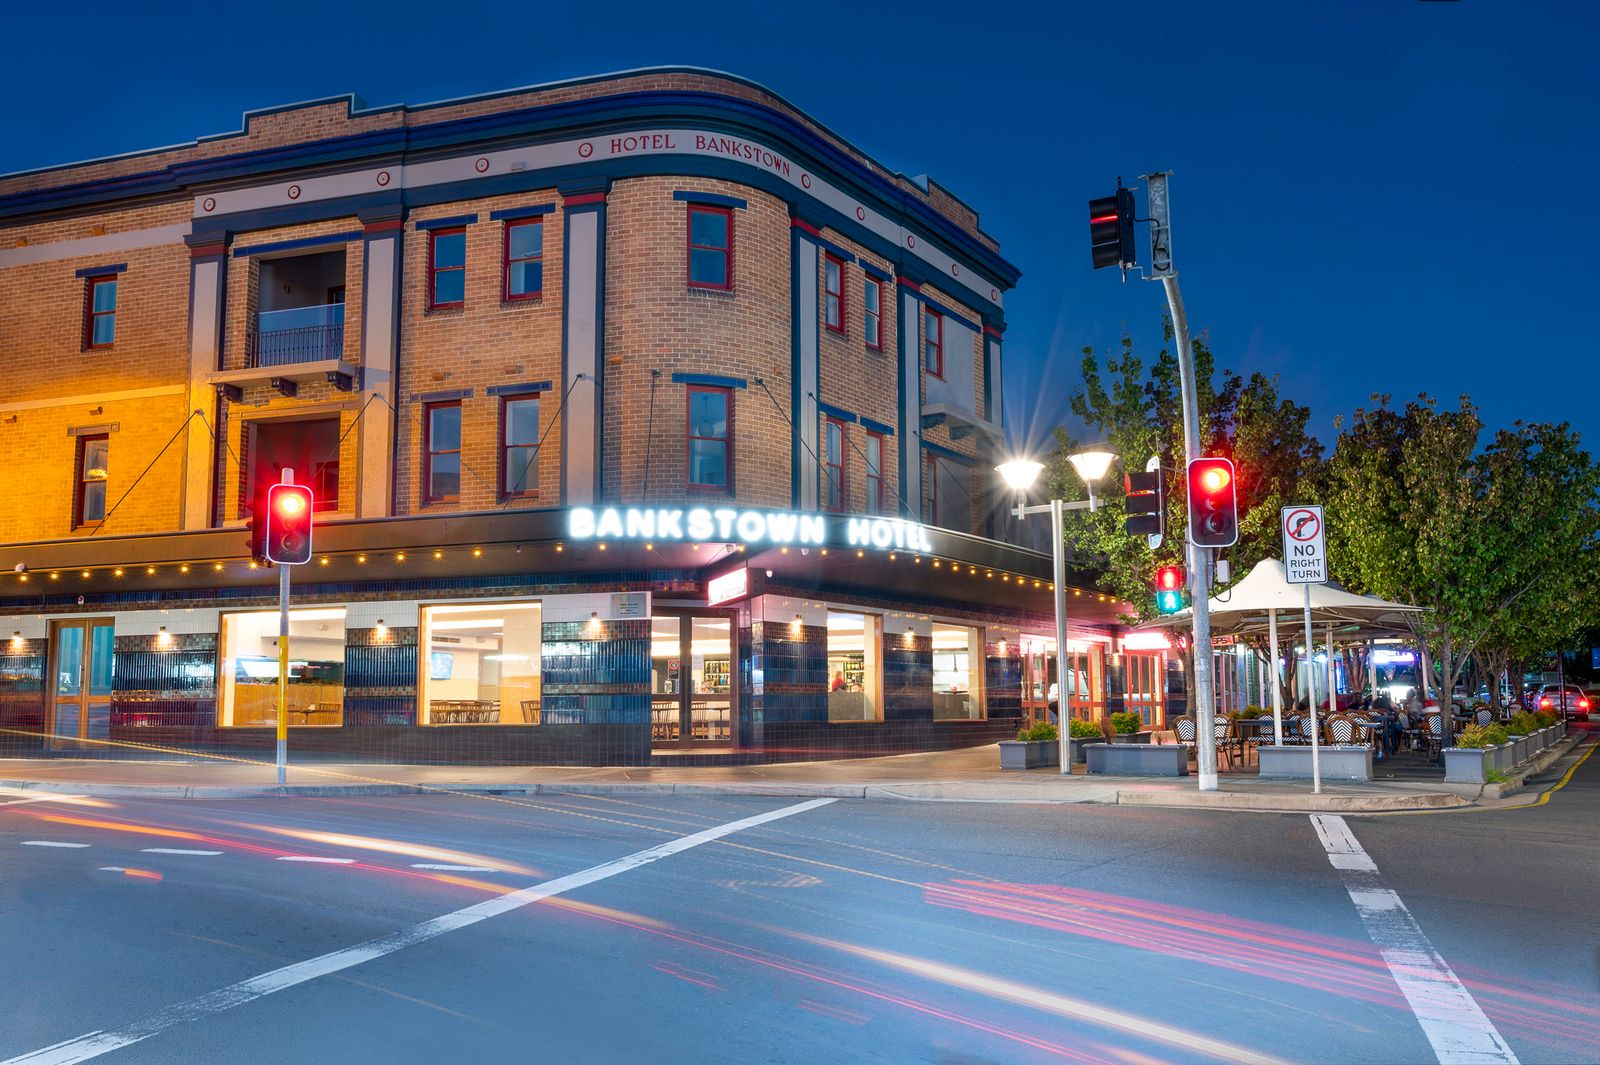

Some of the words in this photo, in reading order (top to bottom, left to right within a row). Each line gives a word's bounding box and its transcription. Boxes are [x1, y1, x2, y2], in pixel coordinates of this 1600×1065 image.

[610, 134, 676, 153] HOTEL
[695, 135, 791, 177] BANKSTOWN
[568, 507, 825, 544] BANKSTOWN
[848, 517, 932, 551] HOTEL
[1294, 544, 1315, 557] NO
[1290, 558, 1321, 568] RIGHT
[1292, 570, 1321, 579] TURN
